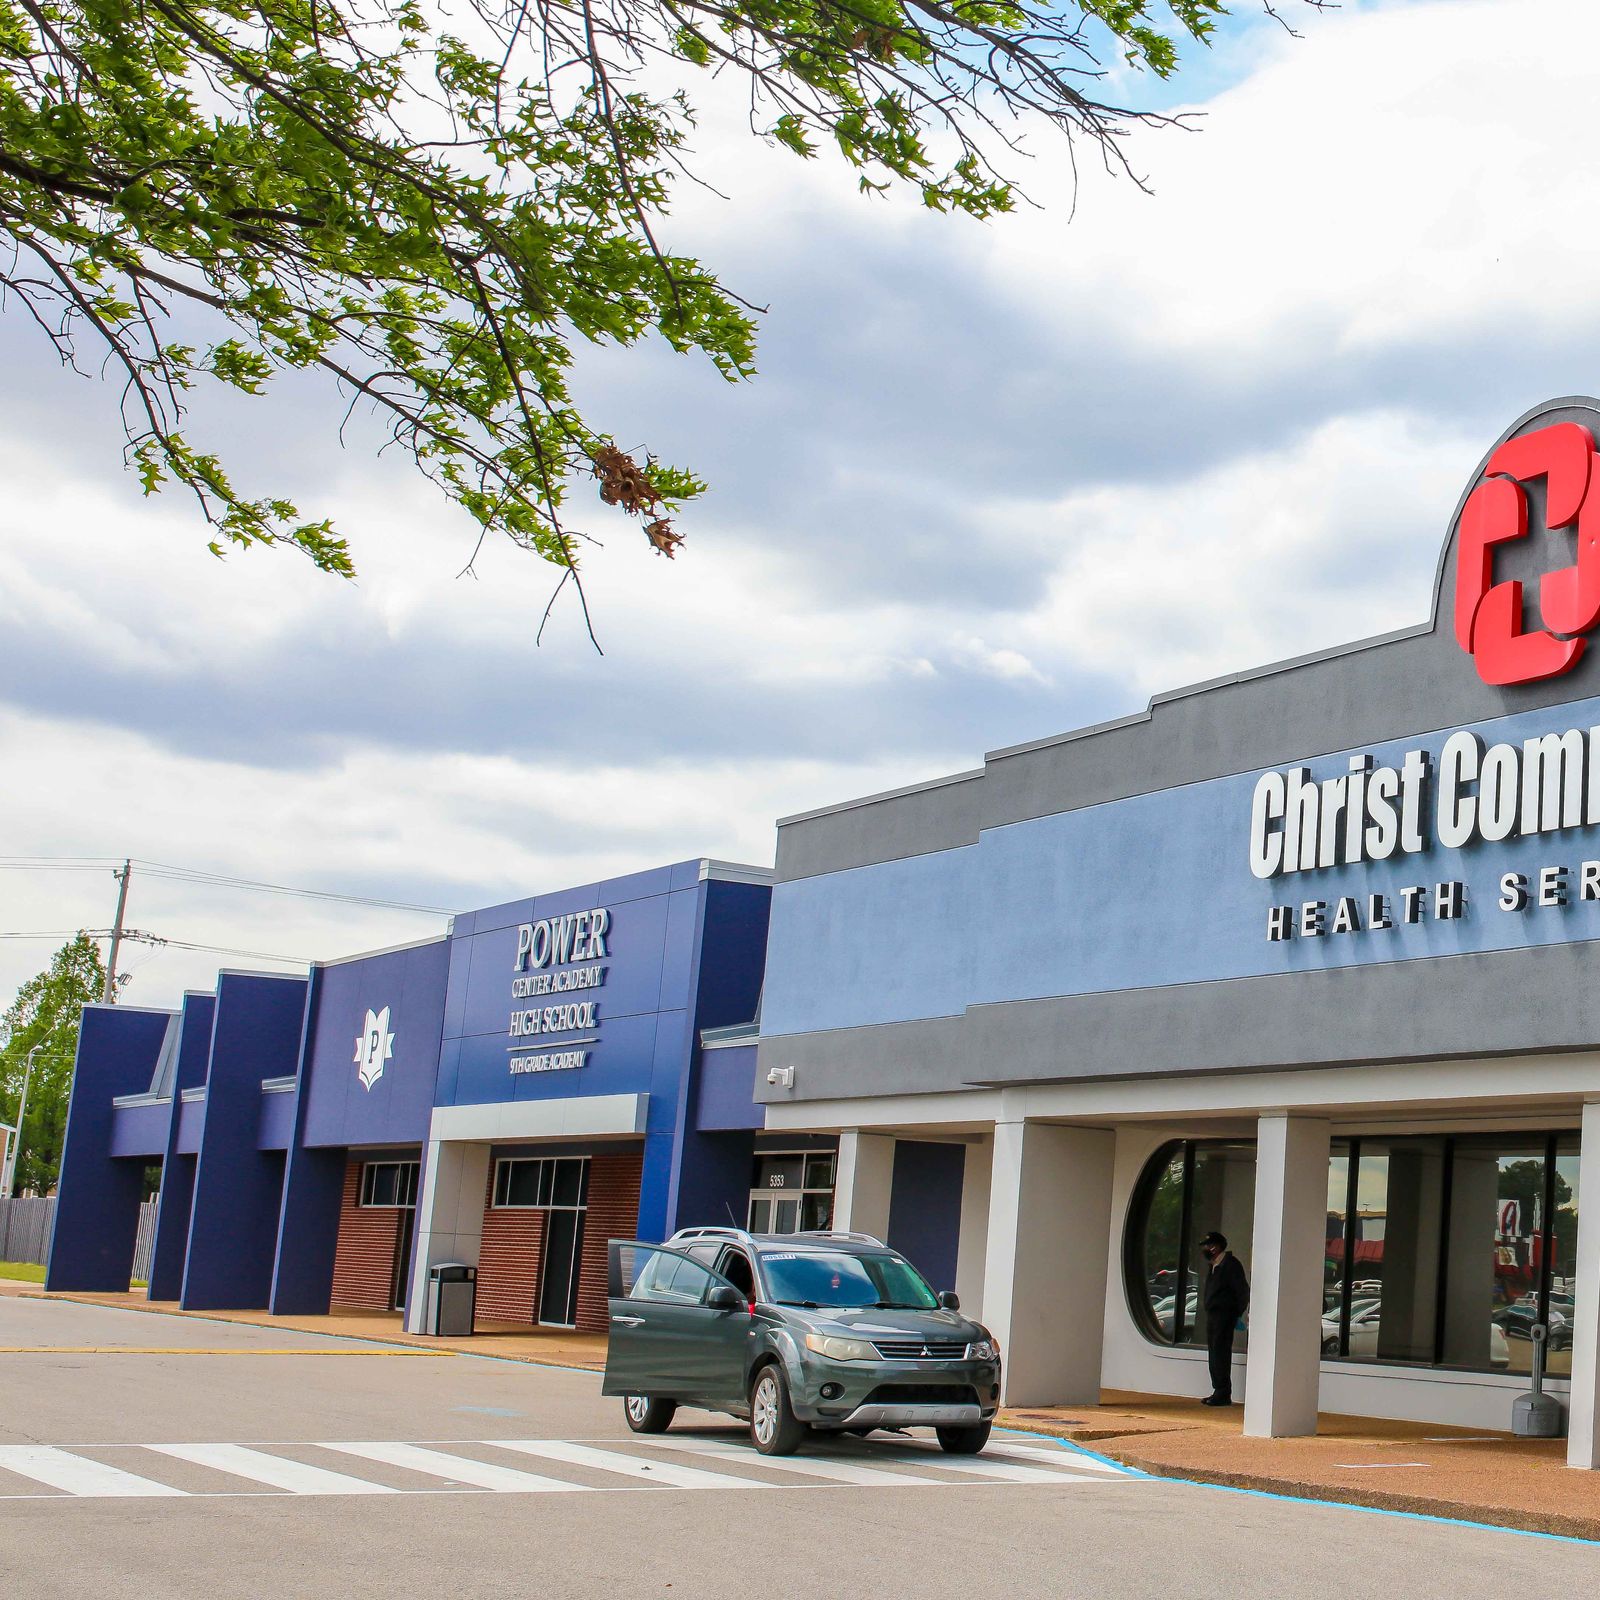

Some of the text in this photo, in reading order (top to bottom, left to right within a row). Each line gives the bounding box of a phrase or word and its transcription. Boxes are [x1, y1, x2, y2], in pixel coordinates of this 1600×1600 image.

[1250, 749, 1430, 879] Christ
[1266, 881, 1463, 942] HEALTH
[513, 908, 608, 972] POWER
[511, 965, 601, 998] CENTER ACADEMY
[509, 1001, 596, 1037] HIGH SCHOOL
[368, 1030, 380, 1064] P
[510, 1050, 586, 1074] 9TH GRADE ACADEMY
[769, 1174, 785, 1187] 5353
